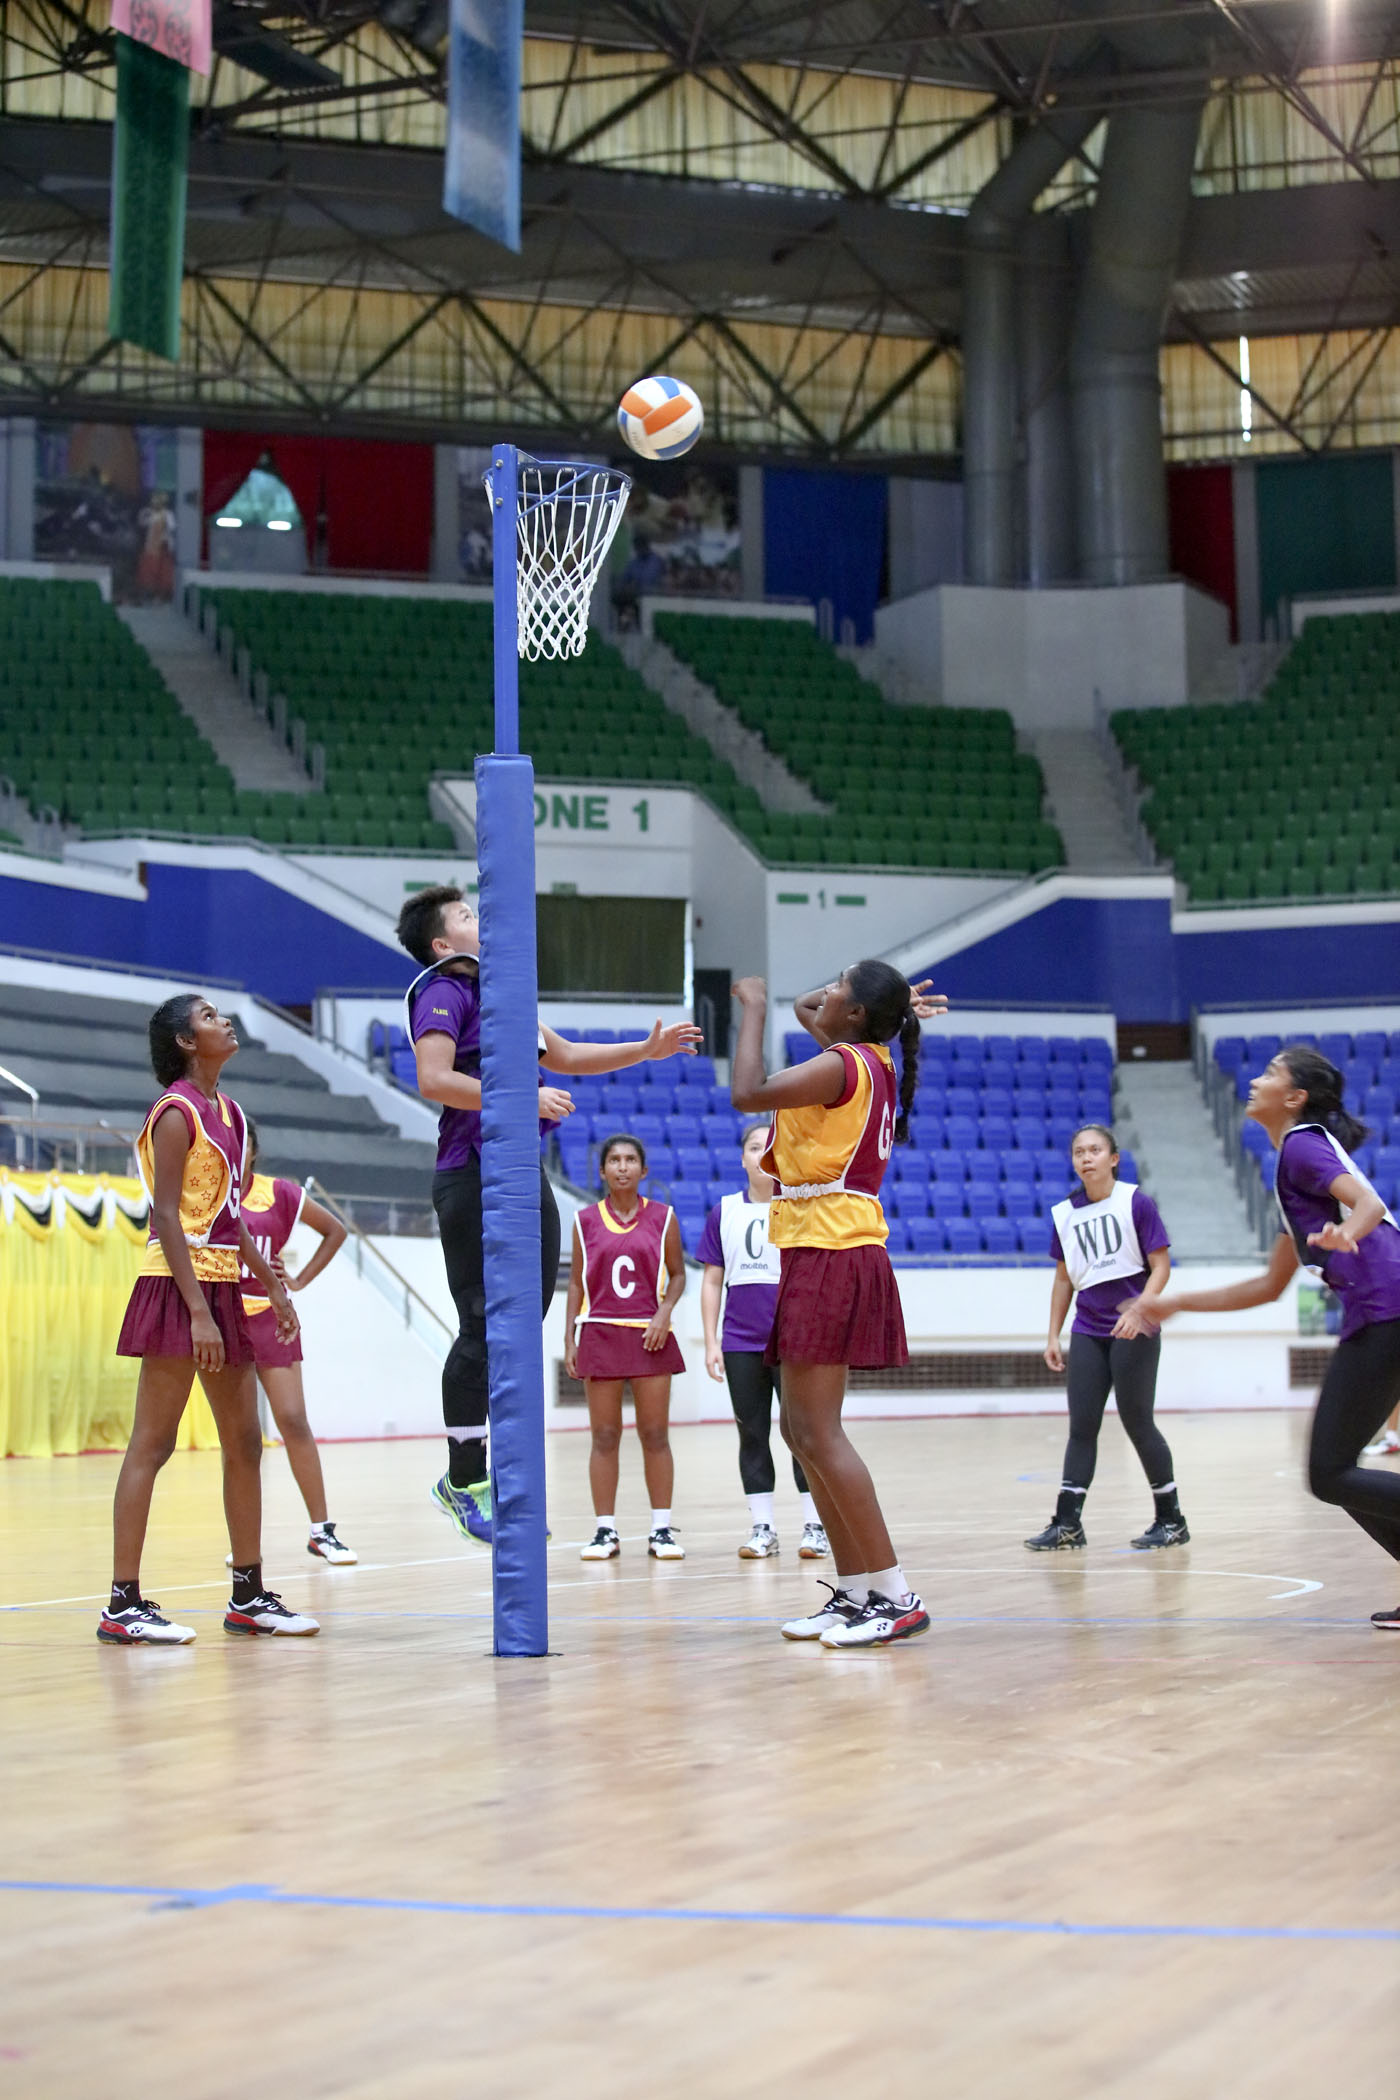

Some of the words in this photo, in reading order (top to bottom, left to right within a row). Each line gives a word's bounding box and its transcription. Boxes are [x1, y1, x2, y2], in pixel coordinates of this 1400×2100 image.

[632, 799, 649, 832] 1
[745, 1218, 765, 1260] C
[1073, 1213, 1122, 1264] WD
[611, 1254, 636, 1299] C
